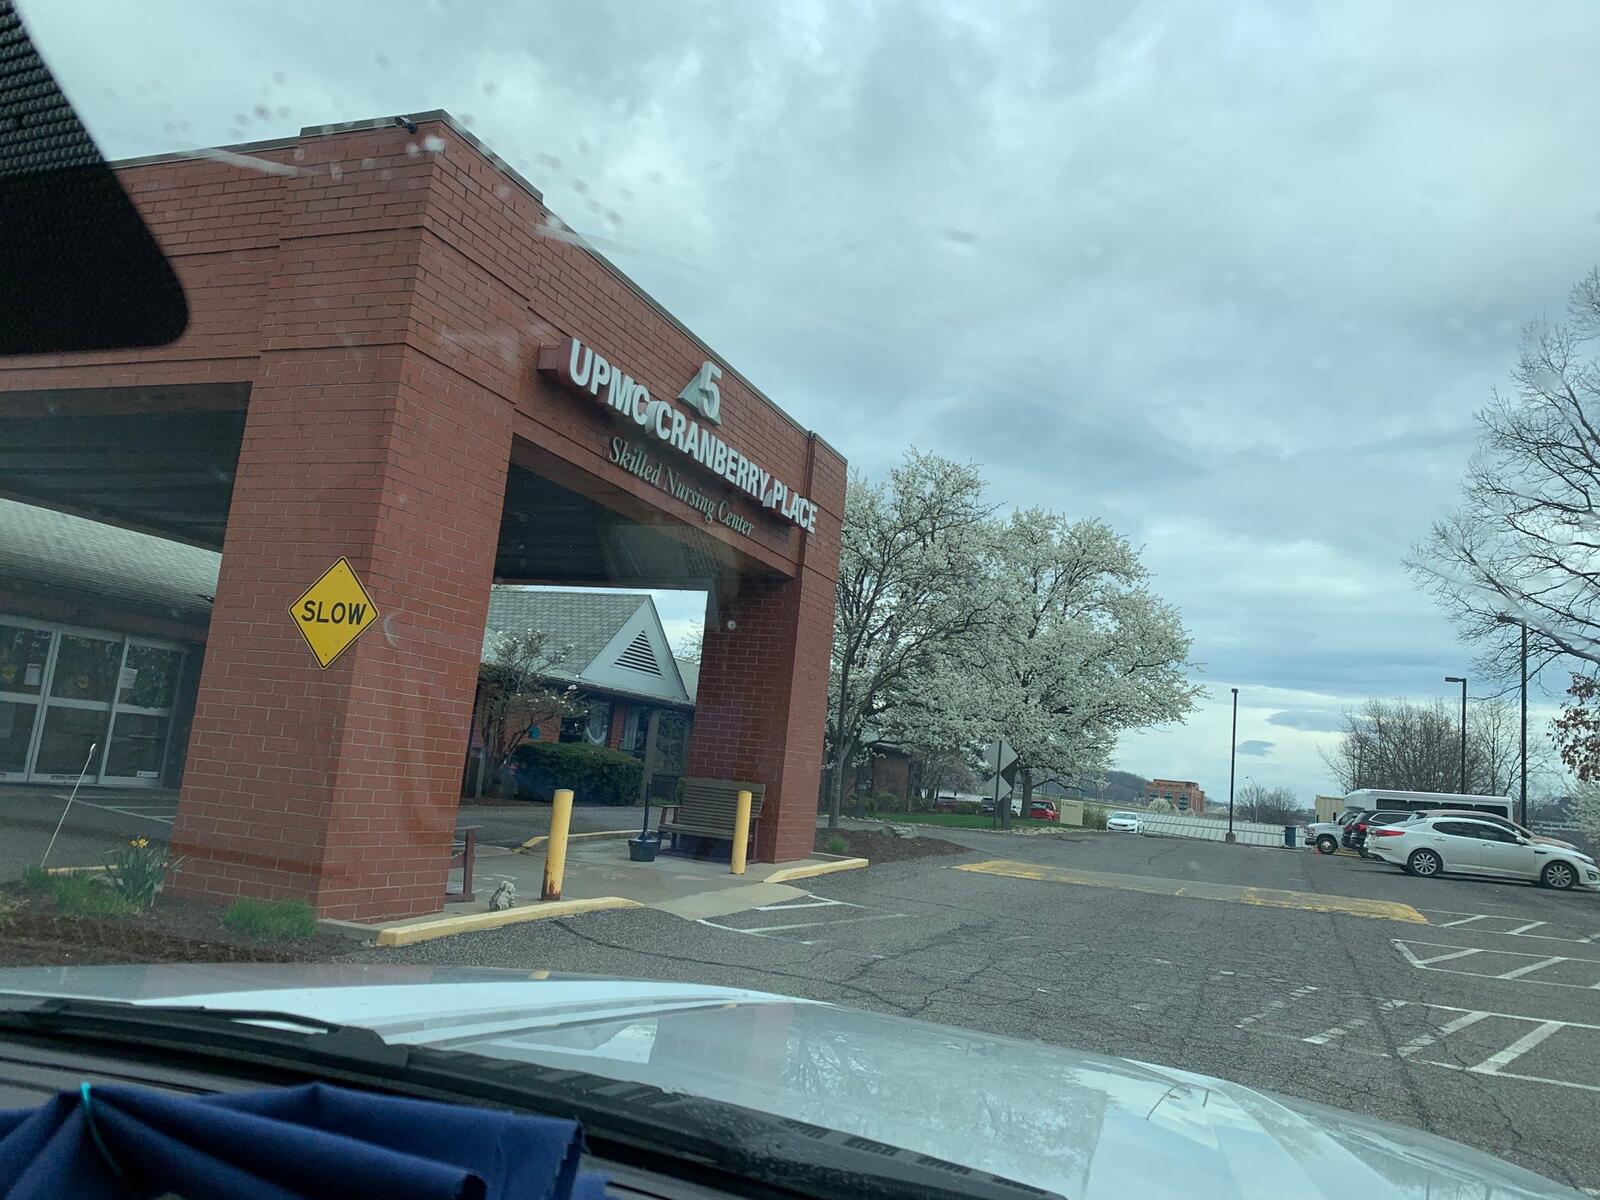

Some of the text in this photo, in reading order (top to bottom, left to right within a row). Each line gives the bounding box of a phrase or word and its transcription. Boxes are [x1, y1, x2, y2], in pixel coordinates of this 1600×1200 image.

[700, 360, 722, 419] 5
[569, 338, 818, 534] UPMC CRANBERRY PLACE
[609, 436, 755, 537] Skilled Nursing Center
[301, 600, 367, 625] SLOW
